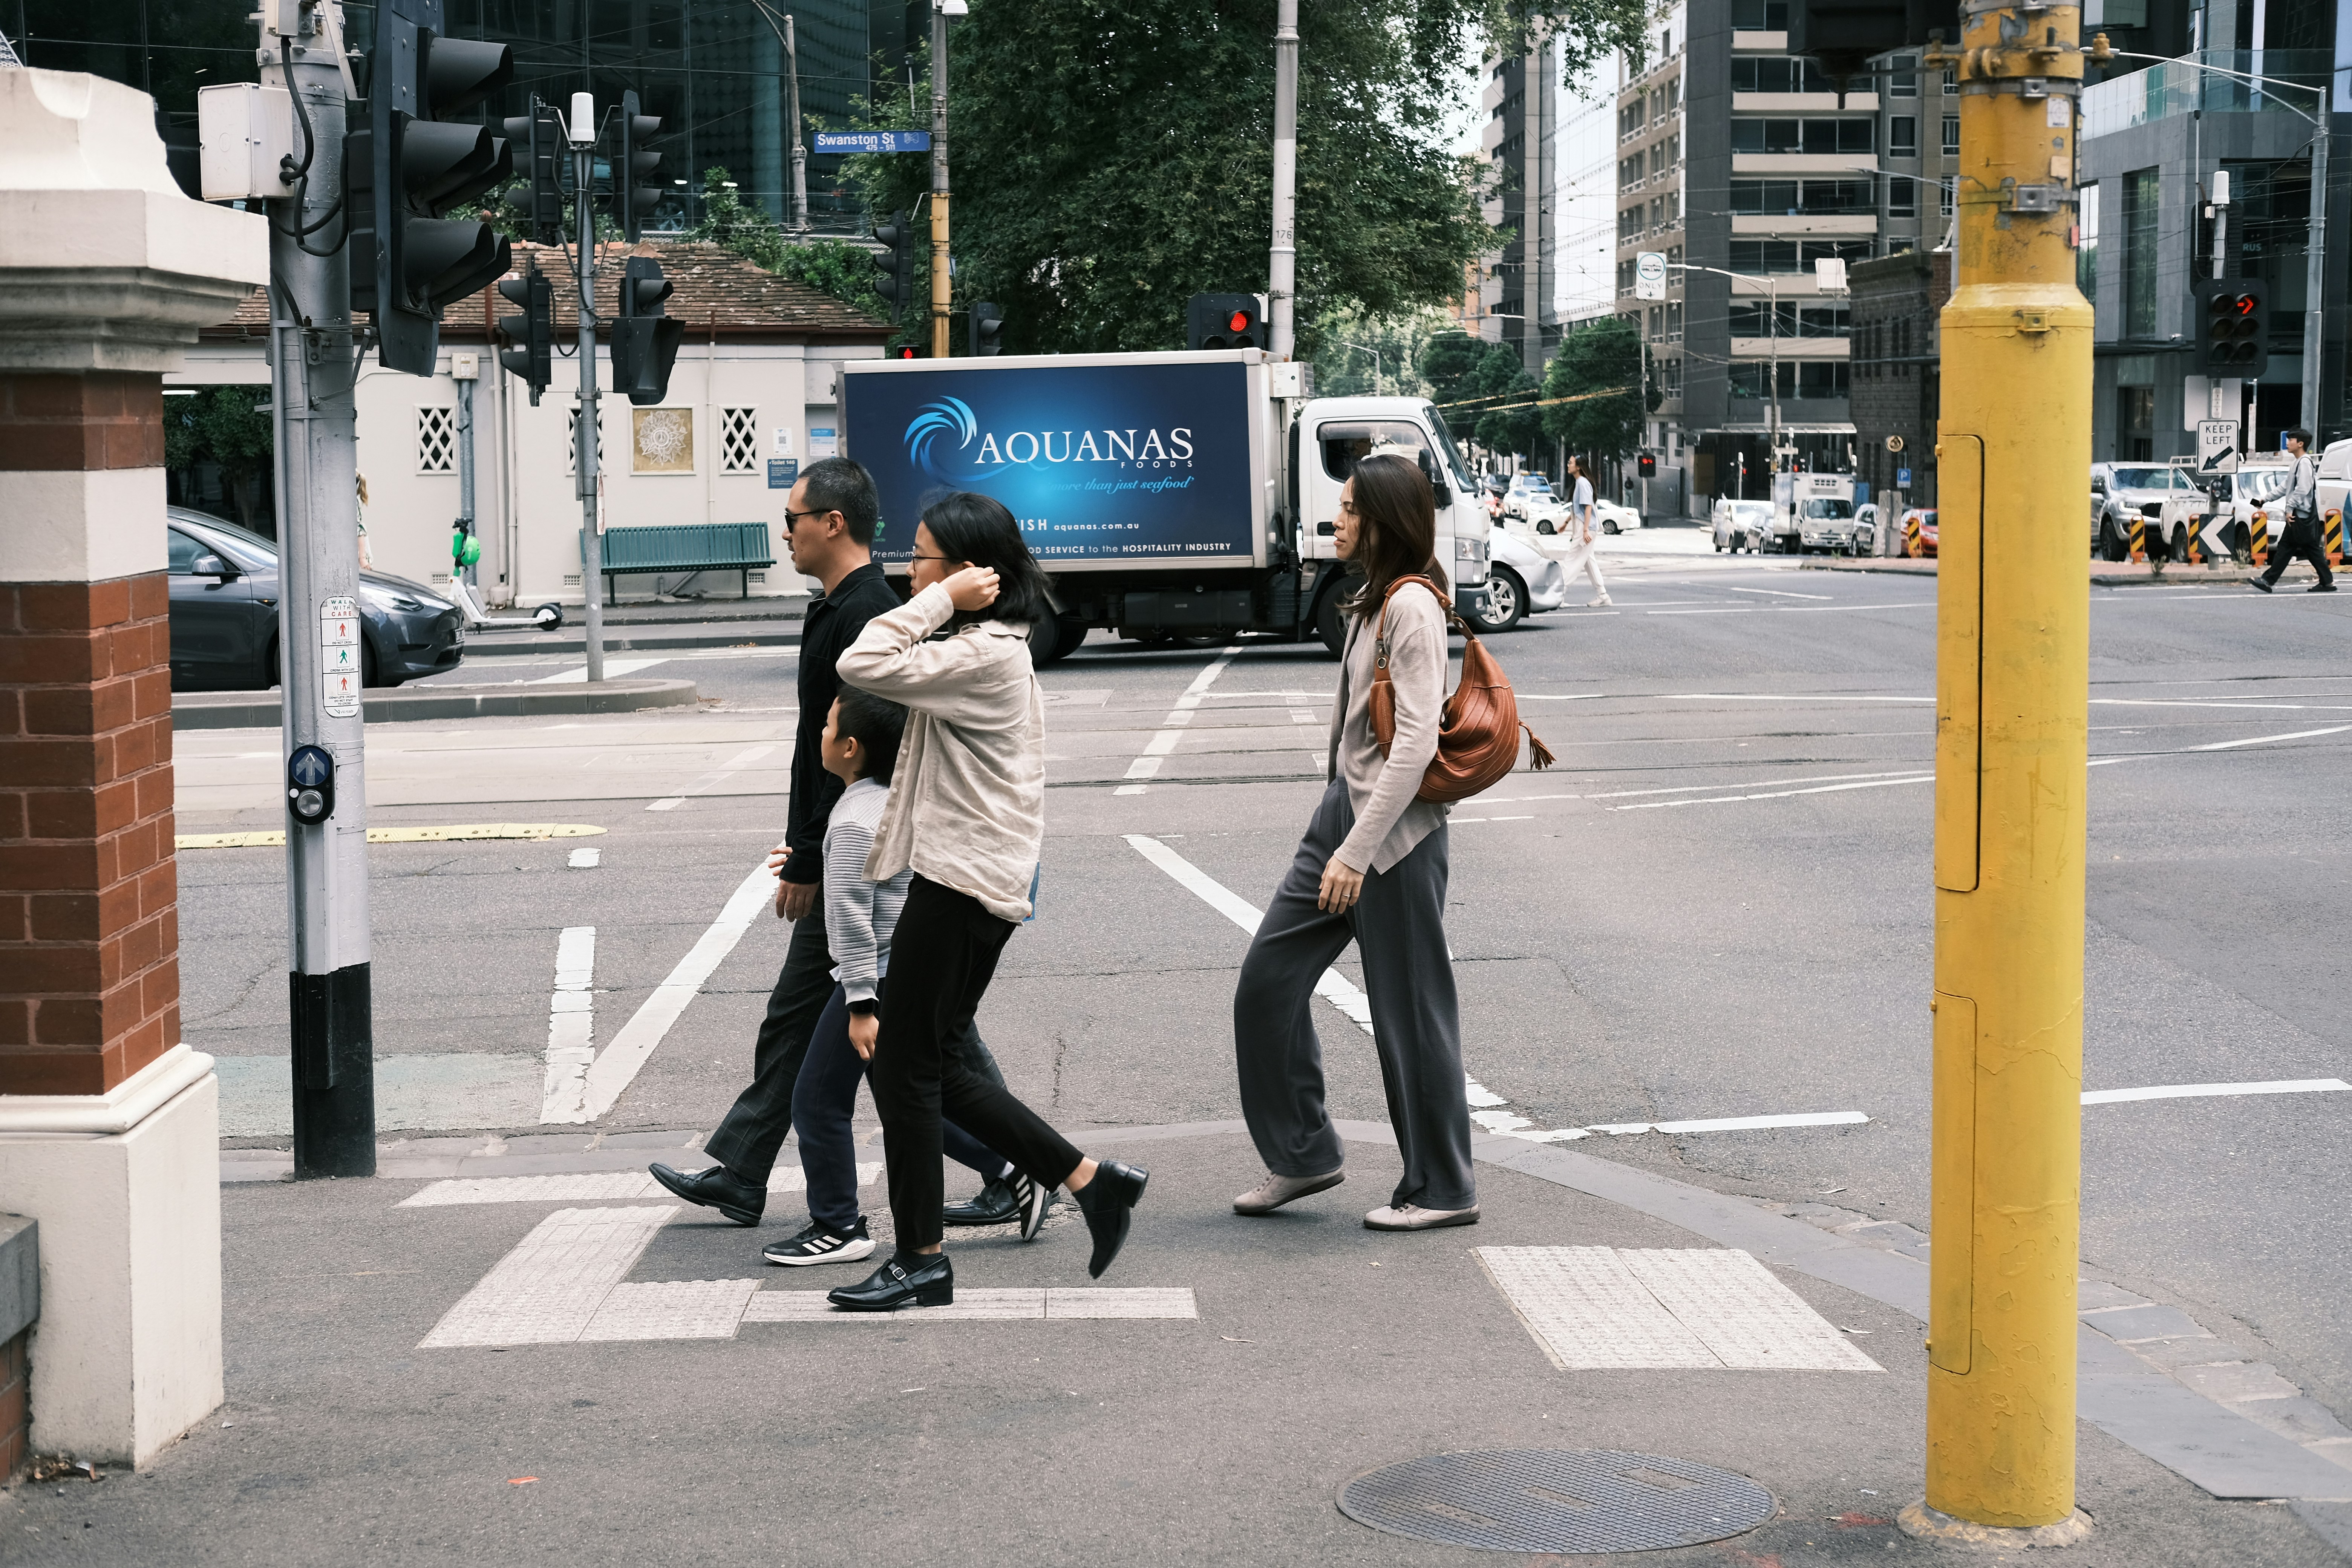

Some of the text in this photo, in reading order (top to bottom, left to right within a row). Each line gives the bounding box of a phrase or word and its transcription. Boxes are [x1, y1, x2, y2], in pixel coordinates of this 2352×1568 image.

[818, 132, 895, 145] Swanston St
[1276, 230, 1292, 239] 176
[2206, 425, 2232, 433] KEEP
[2207, 436, 2231, 444] LEFT
[974, 427, 1193, 464] AQUANAS
[1121, 460, 1192, 469] FOODS
[1900, 471, 1908, 480] P
[1084, 478, 1112, 490] than
[1107, 479, 1139, 494] just
[1015, 519, 1139, 531] ISH aquanas.com.au
[1122, 544, 1181, 552] HOSPITALITY
[1185, 543, 1231, 551] INDUSTRY
